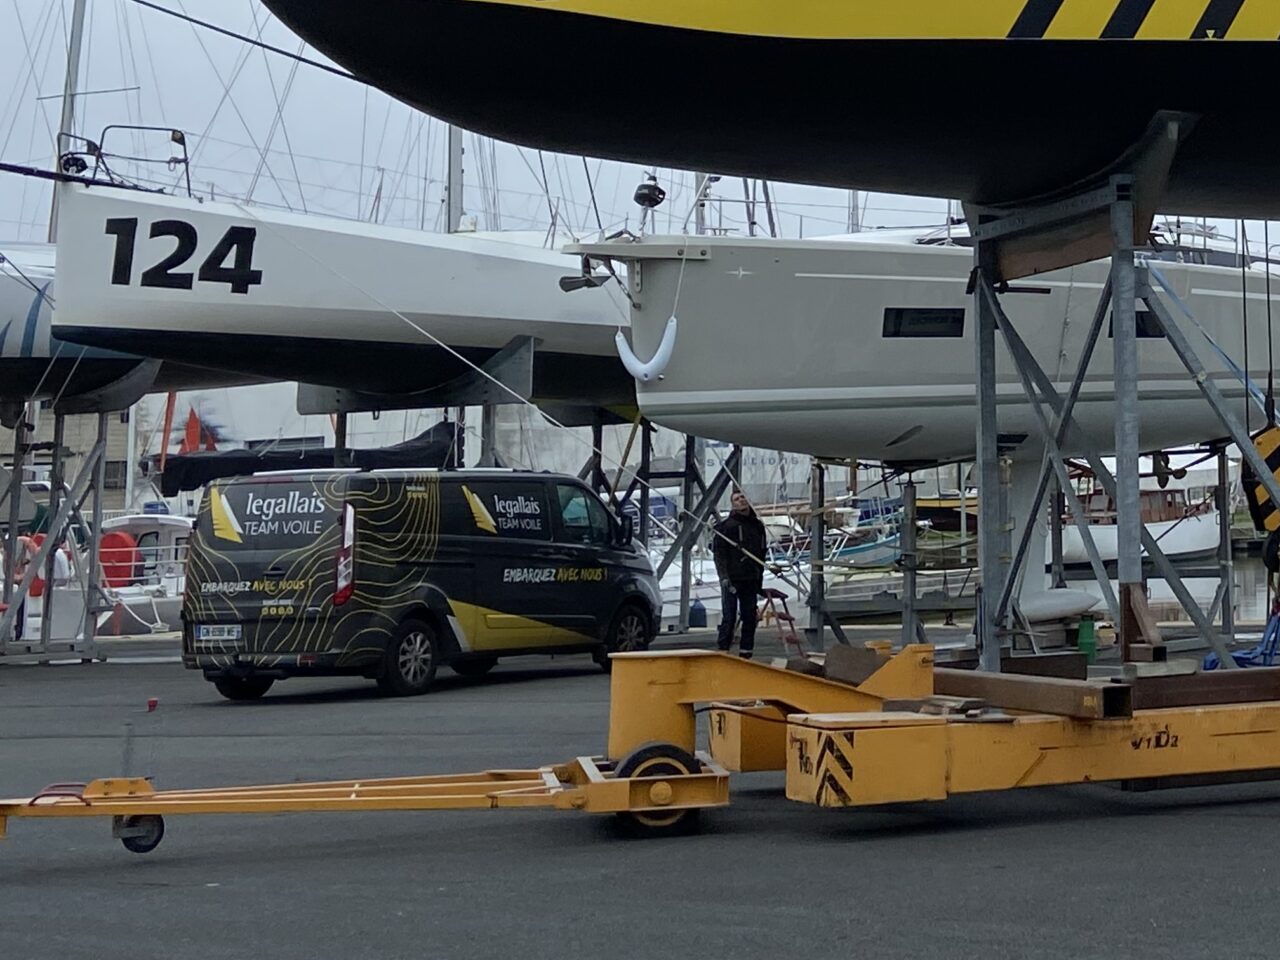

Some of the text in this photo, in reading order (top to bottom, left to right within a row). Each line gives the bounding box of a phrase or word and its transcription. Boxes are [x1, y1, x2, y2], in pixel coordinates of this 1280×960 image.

[105, 217, 263, 294] 124
[246, 491, 326, 520] legallais
[493, 494, 541, 518] legallais
[244, 520, 323, 536] TEAM VOILE
[497, 517, 542, 531] TEAM VOILE
[503, 567, 557, 583] EMBARQUEZ
[557, 567, 579, 582] AVEC
[201, 580, 251, 593] EMBARQUEZ
[252, 579, 277, 591] AVEC
